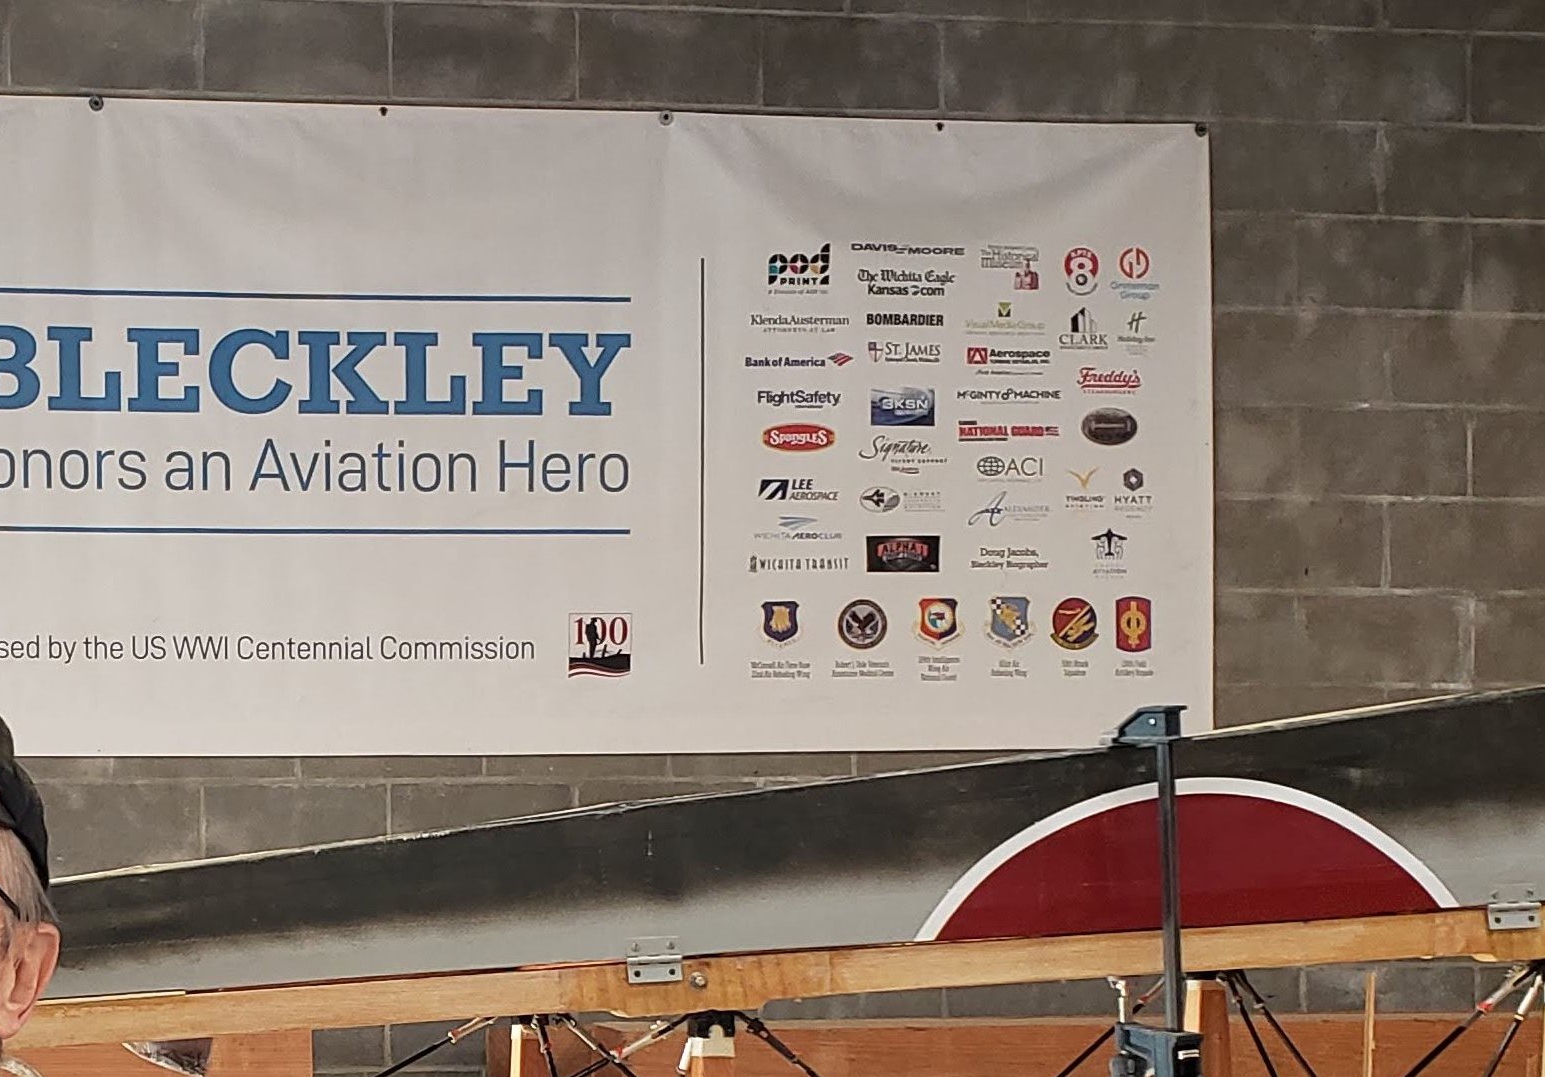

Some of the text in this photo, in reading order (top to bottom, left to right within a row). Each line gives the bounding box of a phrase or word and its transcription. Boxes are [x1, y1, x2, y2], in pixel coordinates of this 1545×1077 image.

[780, 277, 819, 286] PRINT
[857, 269, 956, 285] The Wichita Eagle
[866, 313, 944, 327] BOMBARDIER
[1058, 334, 1109, 346] CLARK
[989, 349, 1051, 359] Aerospace
[745, 356, 826, 367] Bank of America
[1076, 366, 1142, 387] Freddy's
[757, 389, 842, 407] FlightSafety
[958, 426, 1044, 437] NATIONAL GUARD
[858, 434, 932, 462] Signature
[164, 450, 232, 491] an
[249, 438, 478, 493] Aviation
[499, 439, 630, 492] Hero
[1003, 457, 1044, 477] ACI
[791, 478, 814, 491] LEE
[788, 491, 839, 501] AEROSPACE
[1113, 495, 1153, 505] HYATT
[979, 547, 1005, 559] Doug
[759, 557, 850, 571] WICHITA TRANSIT
[48, 635, 76, 664] by
[83, 635, 124, 660] the
[132, 636, 167, 660] US
[173, 636, 229, 660] WWI
[237, 635, 373, 660] Centennial
[380, 635, 535, 661] Commission
